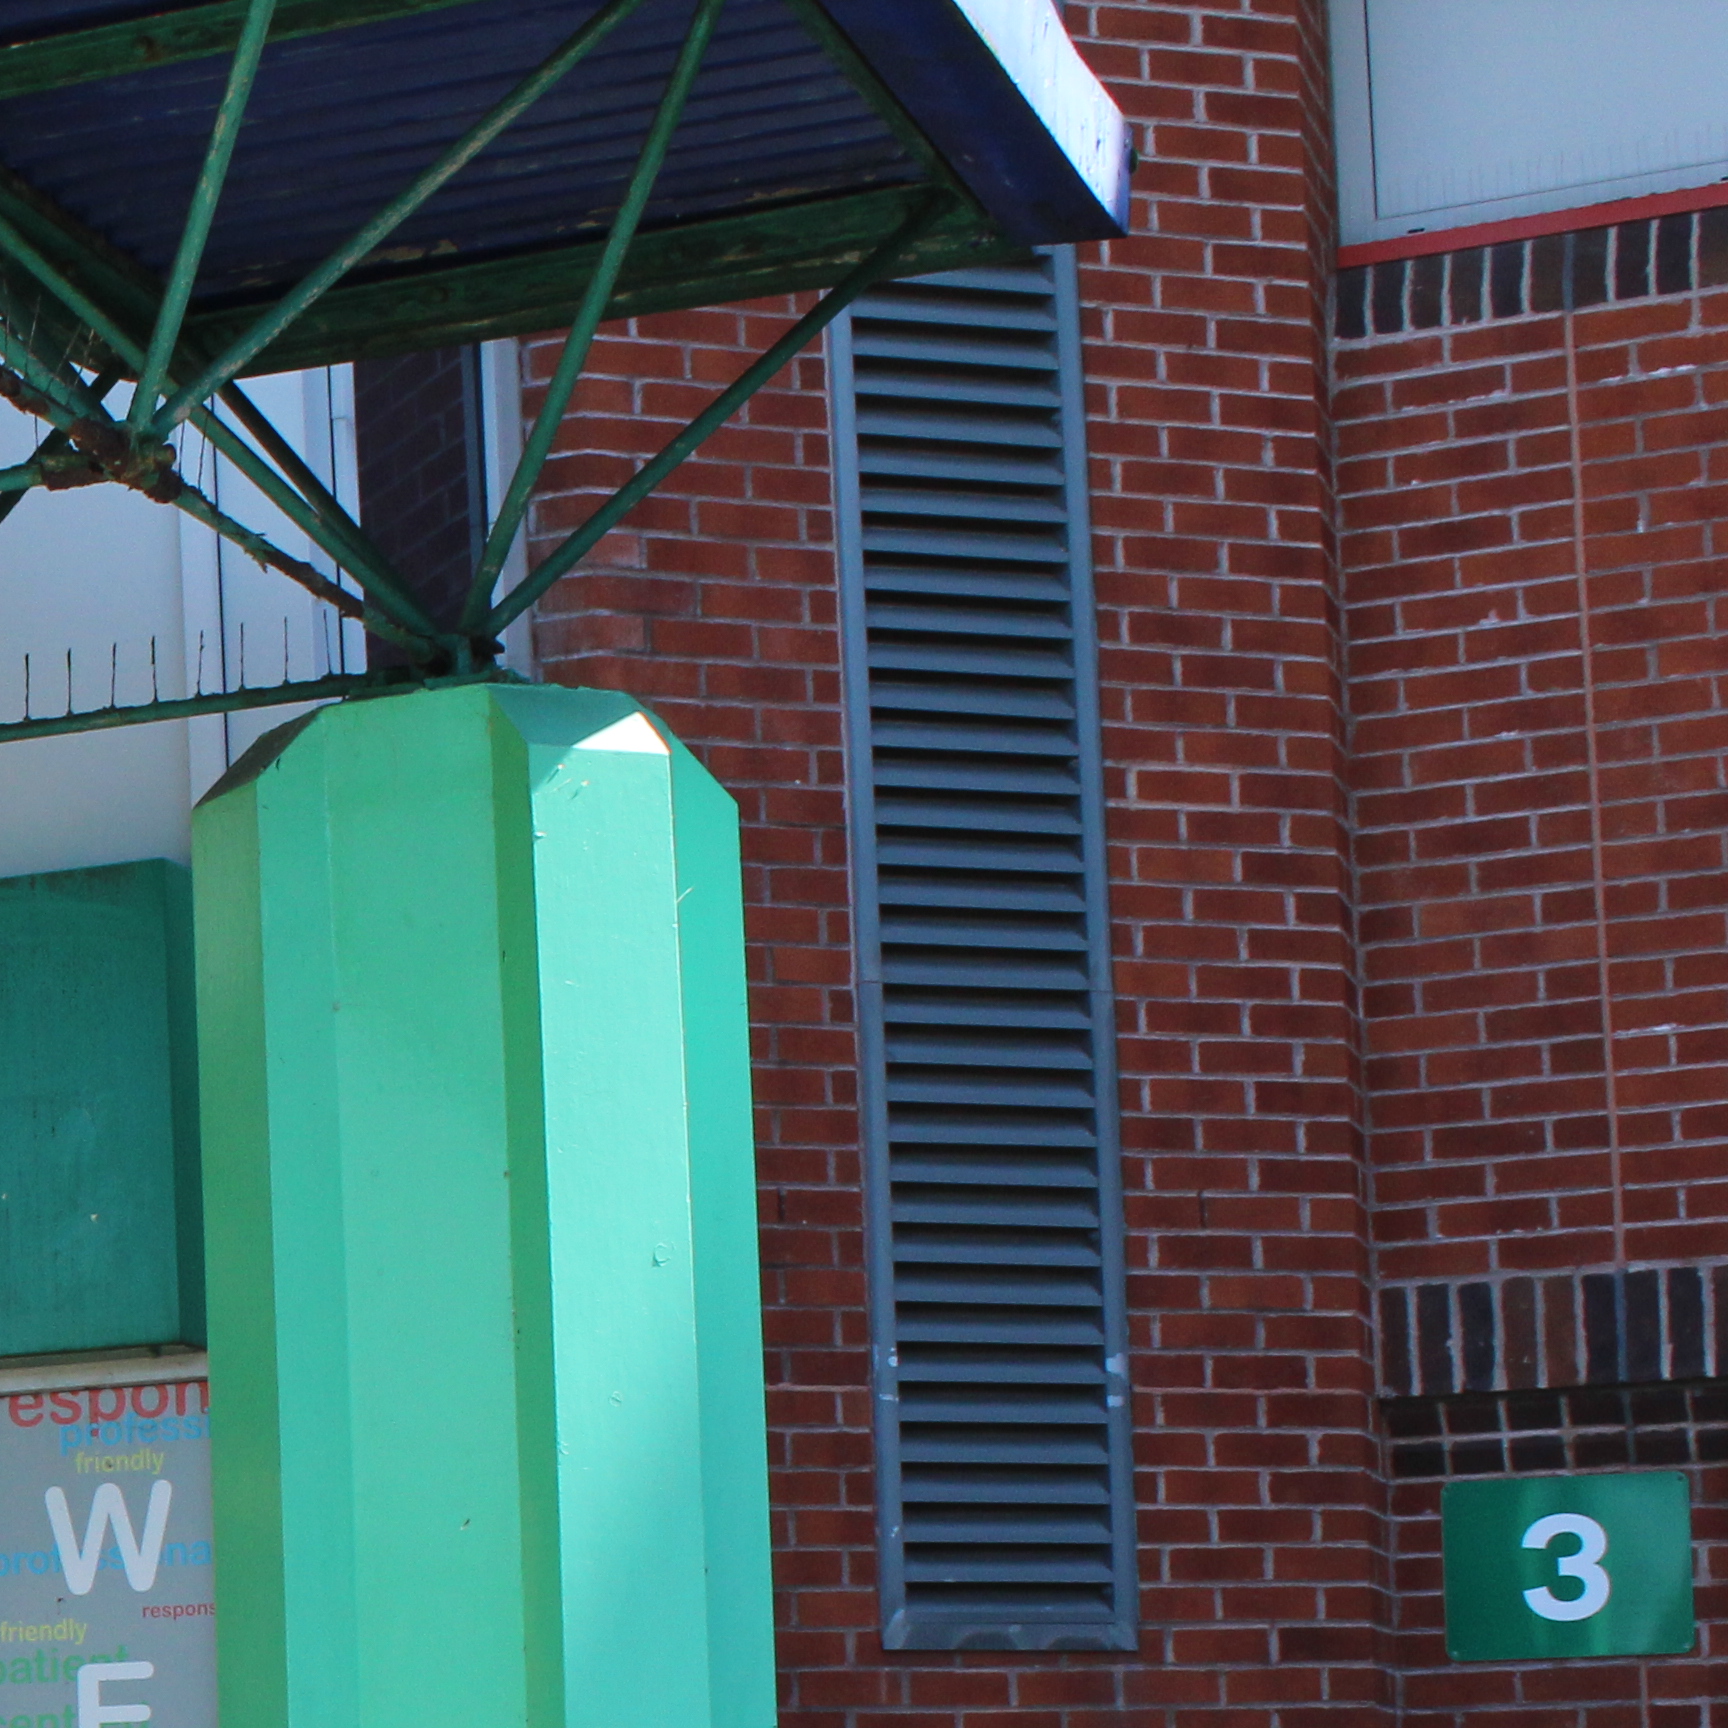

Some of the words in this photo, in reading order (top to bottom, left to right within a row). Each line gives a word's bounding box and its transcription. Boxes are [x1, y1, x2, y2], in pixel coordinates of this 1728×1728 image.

[75, 1448, 164, 1475] friendly
[1521, 1512, 1612, 1622] 3
[0, 1618, 87, 1645] friendly
